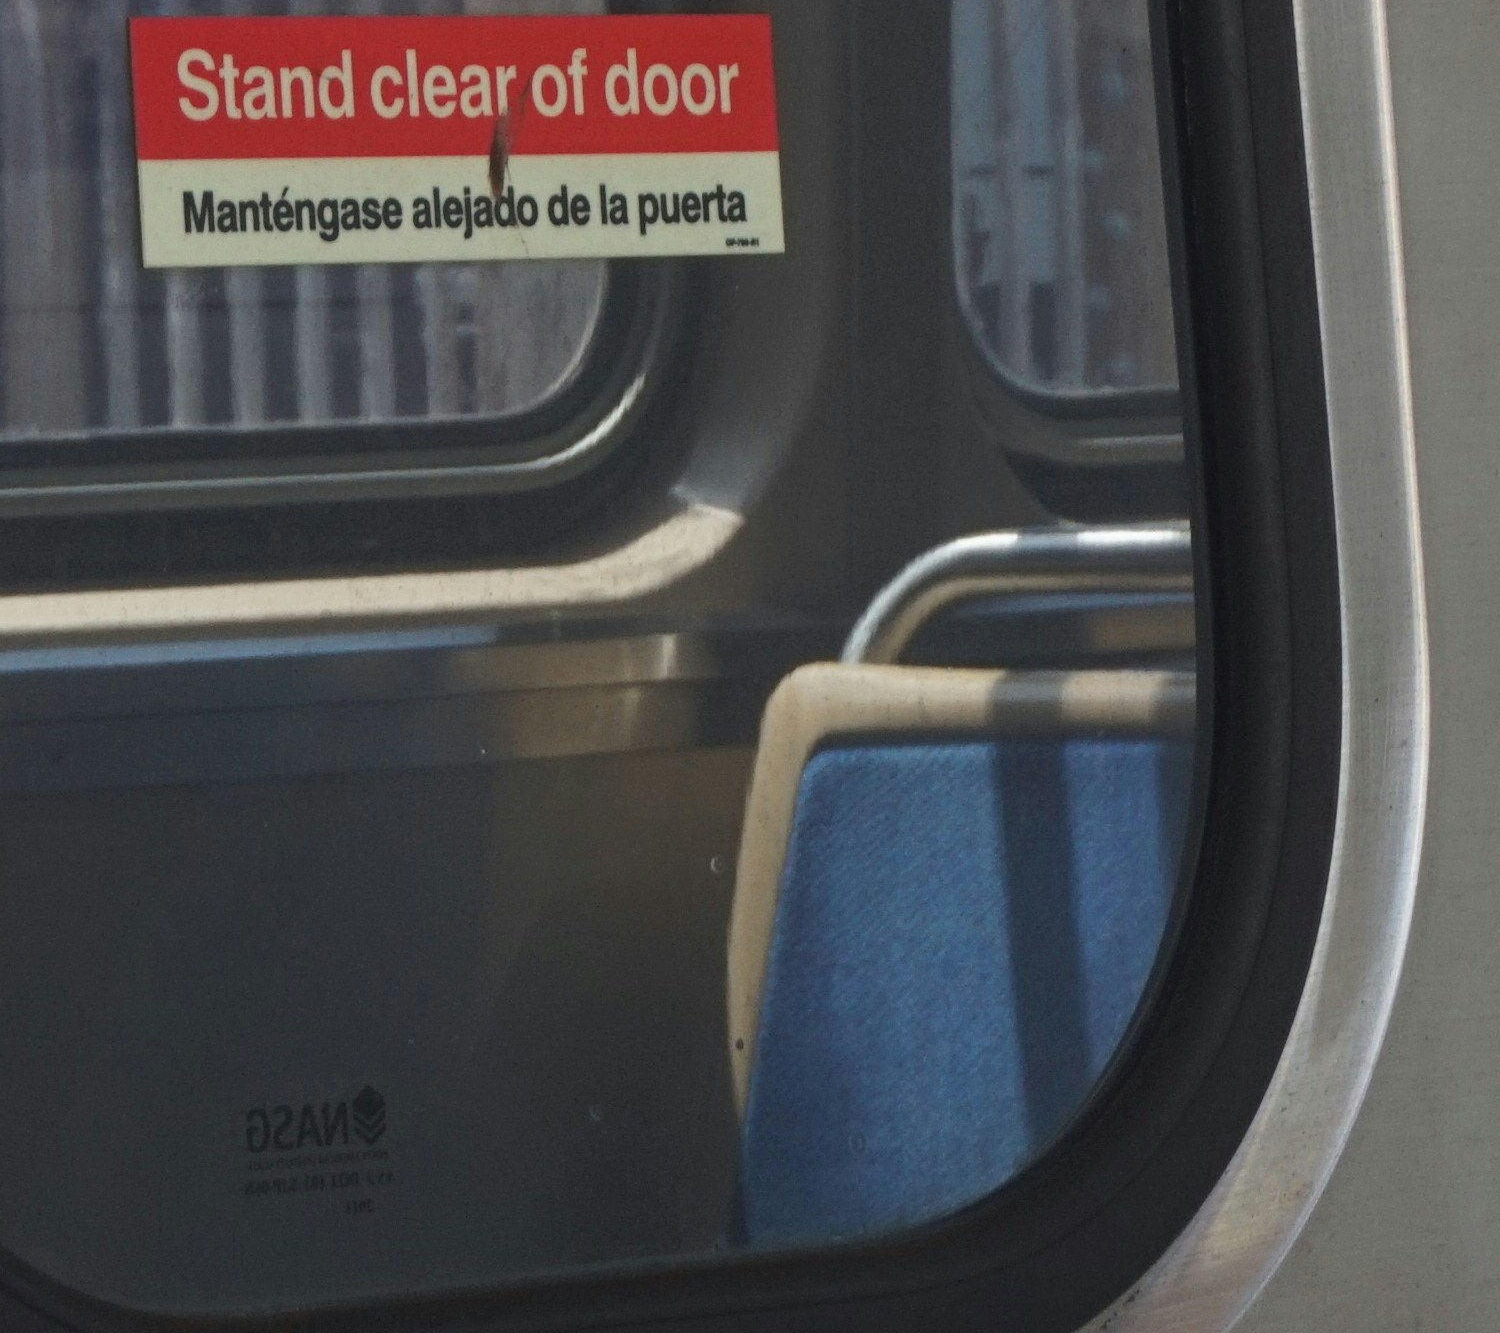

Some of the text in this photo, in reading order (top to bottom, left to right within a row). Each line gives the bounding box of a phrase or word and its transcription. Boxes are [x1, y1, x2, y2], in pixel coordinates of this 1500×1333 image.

[176, 47, 739, 121] Stand clear of door
[182, 184, 748, 242] Manténgase alejado de la puerta
